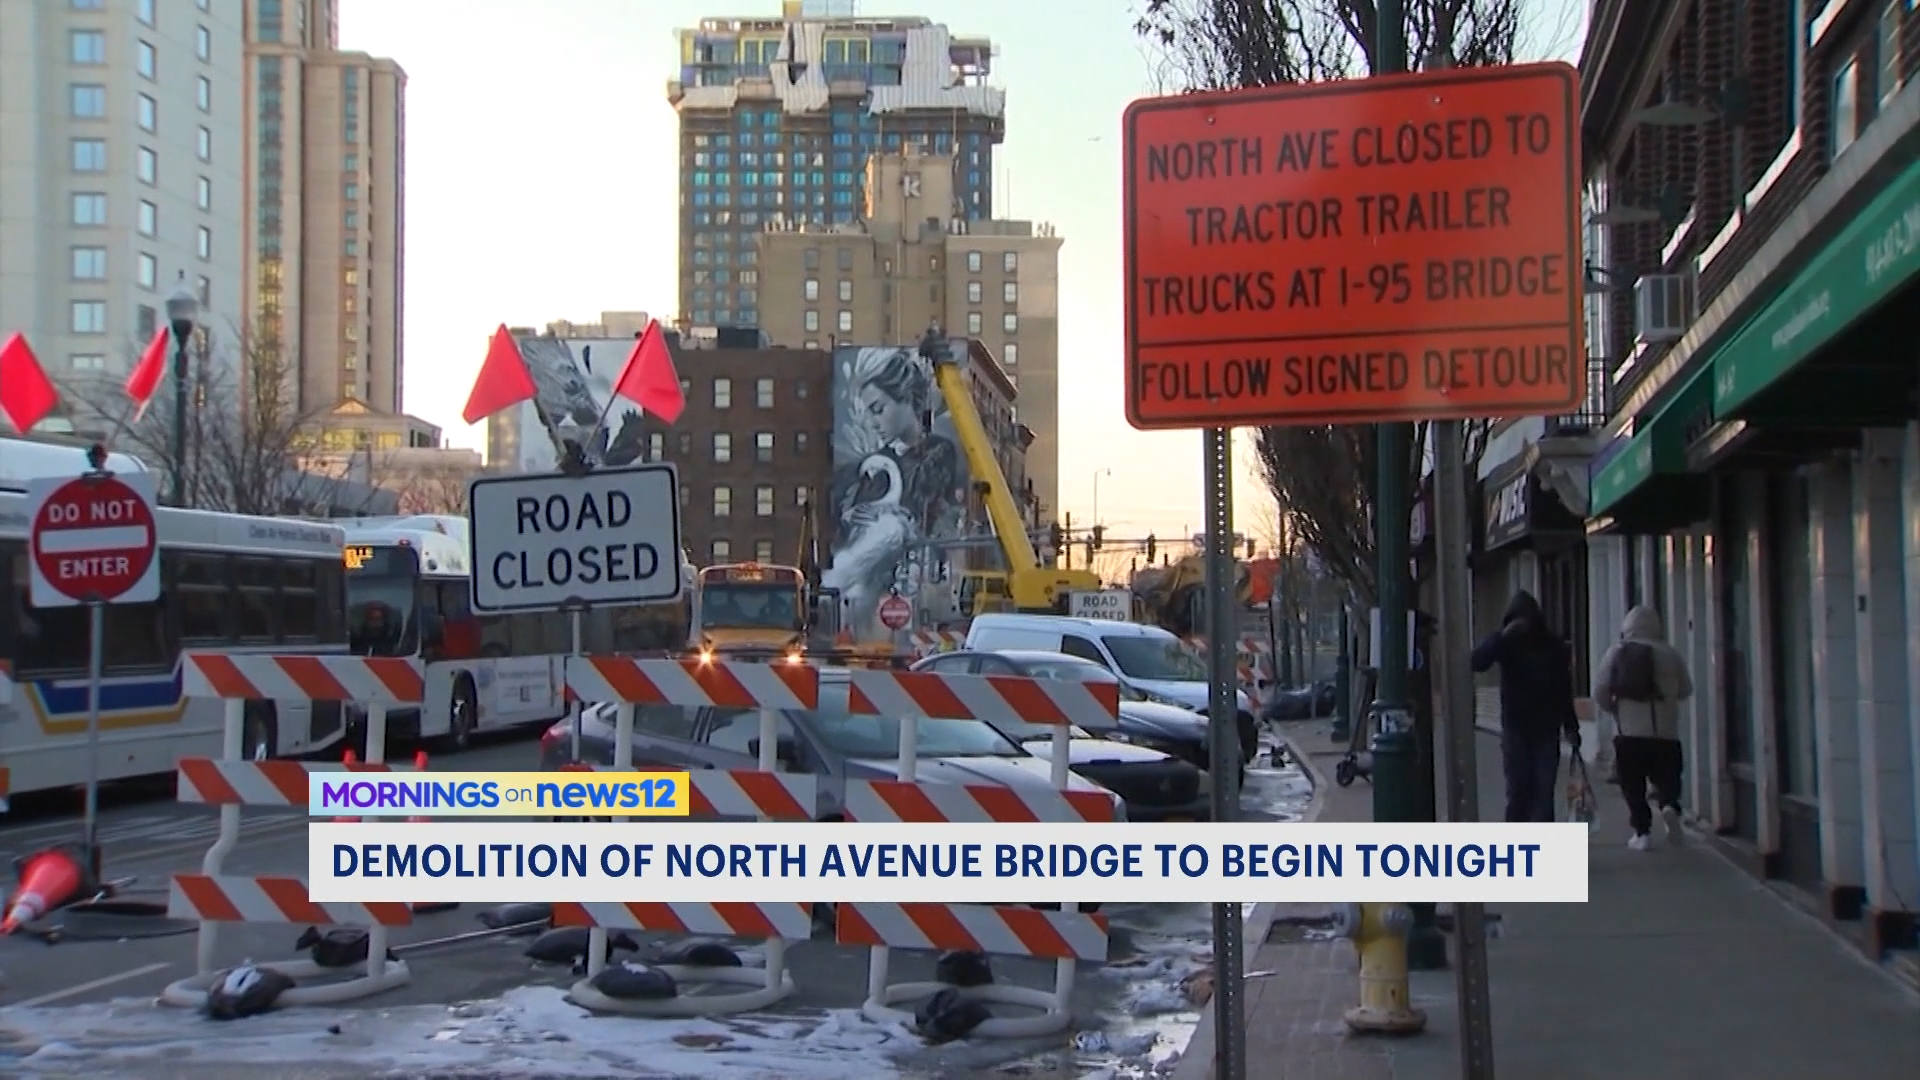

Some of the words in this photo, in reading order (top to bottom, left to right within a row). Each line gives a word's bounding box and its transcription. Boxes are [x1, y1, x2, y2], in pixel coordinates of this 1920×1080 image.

[1147, 137, 1263, 182] NORTH
[1277, 130, 1340, 172] AVE
[1351, 117, 1493, 168] CLOSED
[1506, 114, 1551, 155] TO
[1186, 199, 1343, 246] TRACTOR
[1357, 188, 1511, 236] TRAILER
[1143, 272, 1275, 317] TRUCKS
[1288, 268, 1326, 309] AT
[1339, 264, 1412, 307] I-95
[1426, 254, 1564, 301] BRIDGE
[1140, 358, 1271, 402] FOLLOW
[1284, 351, 1409, 396] SIGNED
[1424, 344, 1568, 390] DETOUR
[49, 503, 79, 523] DO
[90, 500, 136, 520] NOT
[516, 490, 631, 534] ROAD
[59, 557, 129, 579] ENTER
[493, 542, 659, 590] CLOSED
[1076, 610, 1126, 621] CLOSED
[1082, 595, 1118, 607] ROAD
